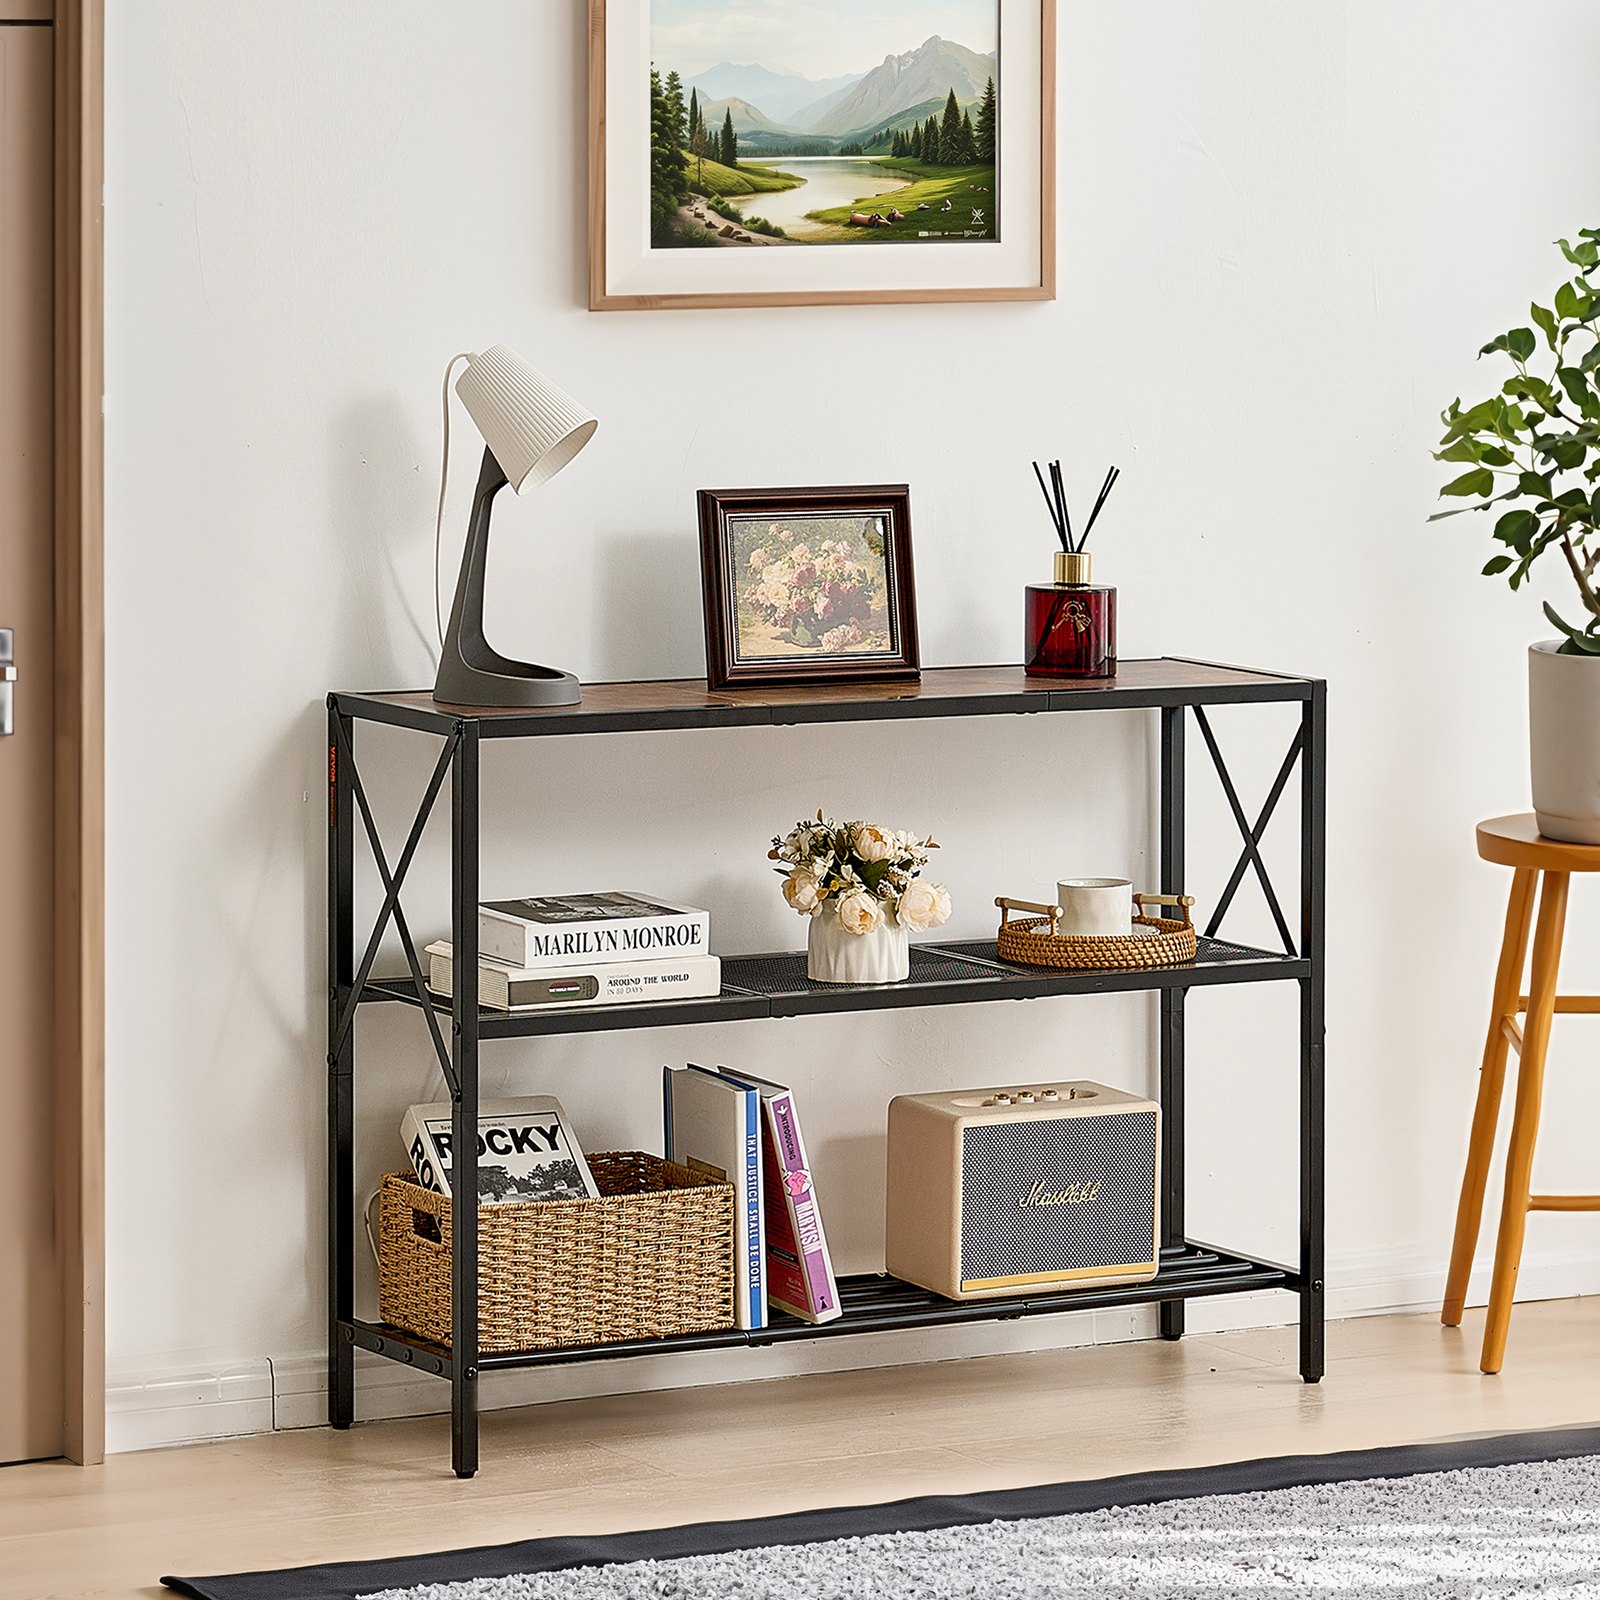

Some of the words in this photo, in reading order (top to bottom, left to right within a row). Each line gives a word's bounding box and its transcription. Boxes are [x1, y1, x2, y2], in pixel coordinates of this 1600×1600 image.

[533, 930, 618, 957] MARILYN
[622, 923, 702, 950] MONROE
[608, 978, 641, 987] AROUND
[644, 976, 659, 984] THE
[661, 973, 690, 983] WORLD
[432, 1125, 560, 1158] RCKY
[747, 1134, 757, 1158] THAT
[781, 1113, 796, 1161] INTRODUCING
[411, 1133, 442, 1194] RO
[748, 1165, 758, 1203] JUSTICE
[748, 1210, 760, 1239] SHALL
[795, 1200, 822, 1256] MARXISM
[749, 1246, 760, 1257] BE
[750, 1261, 760, 1288] DONE
